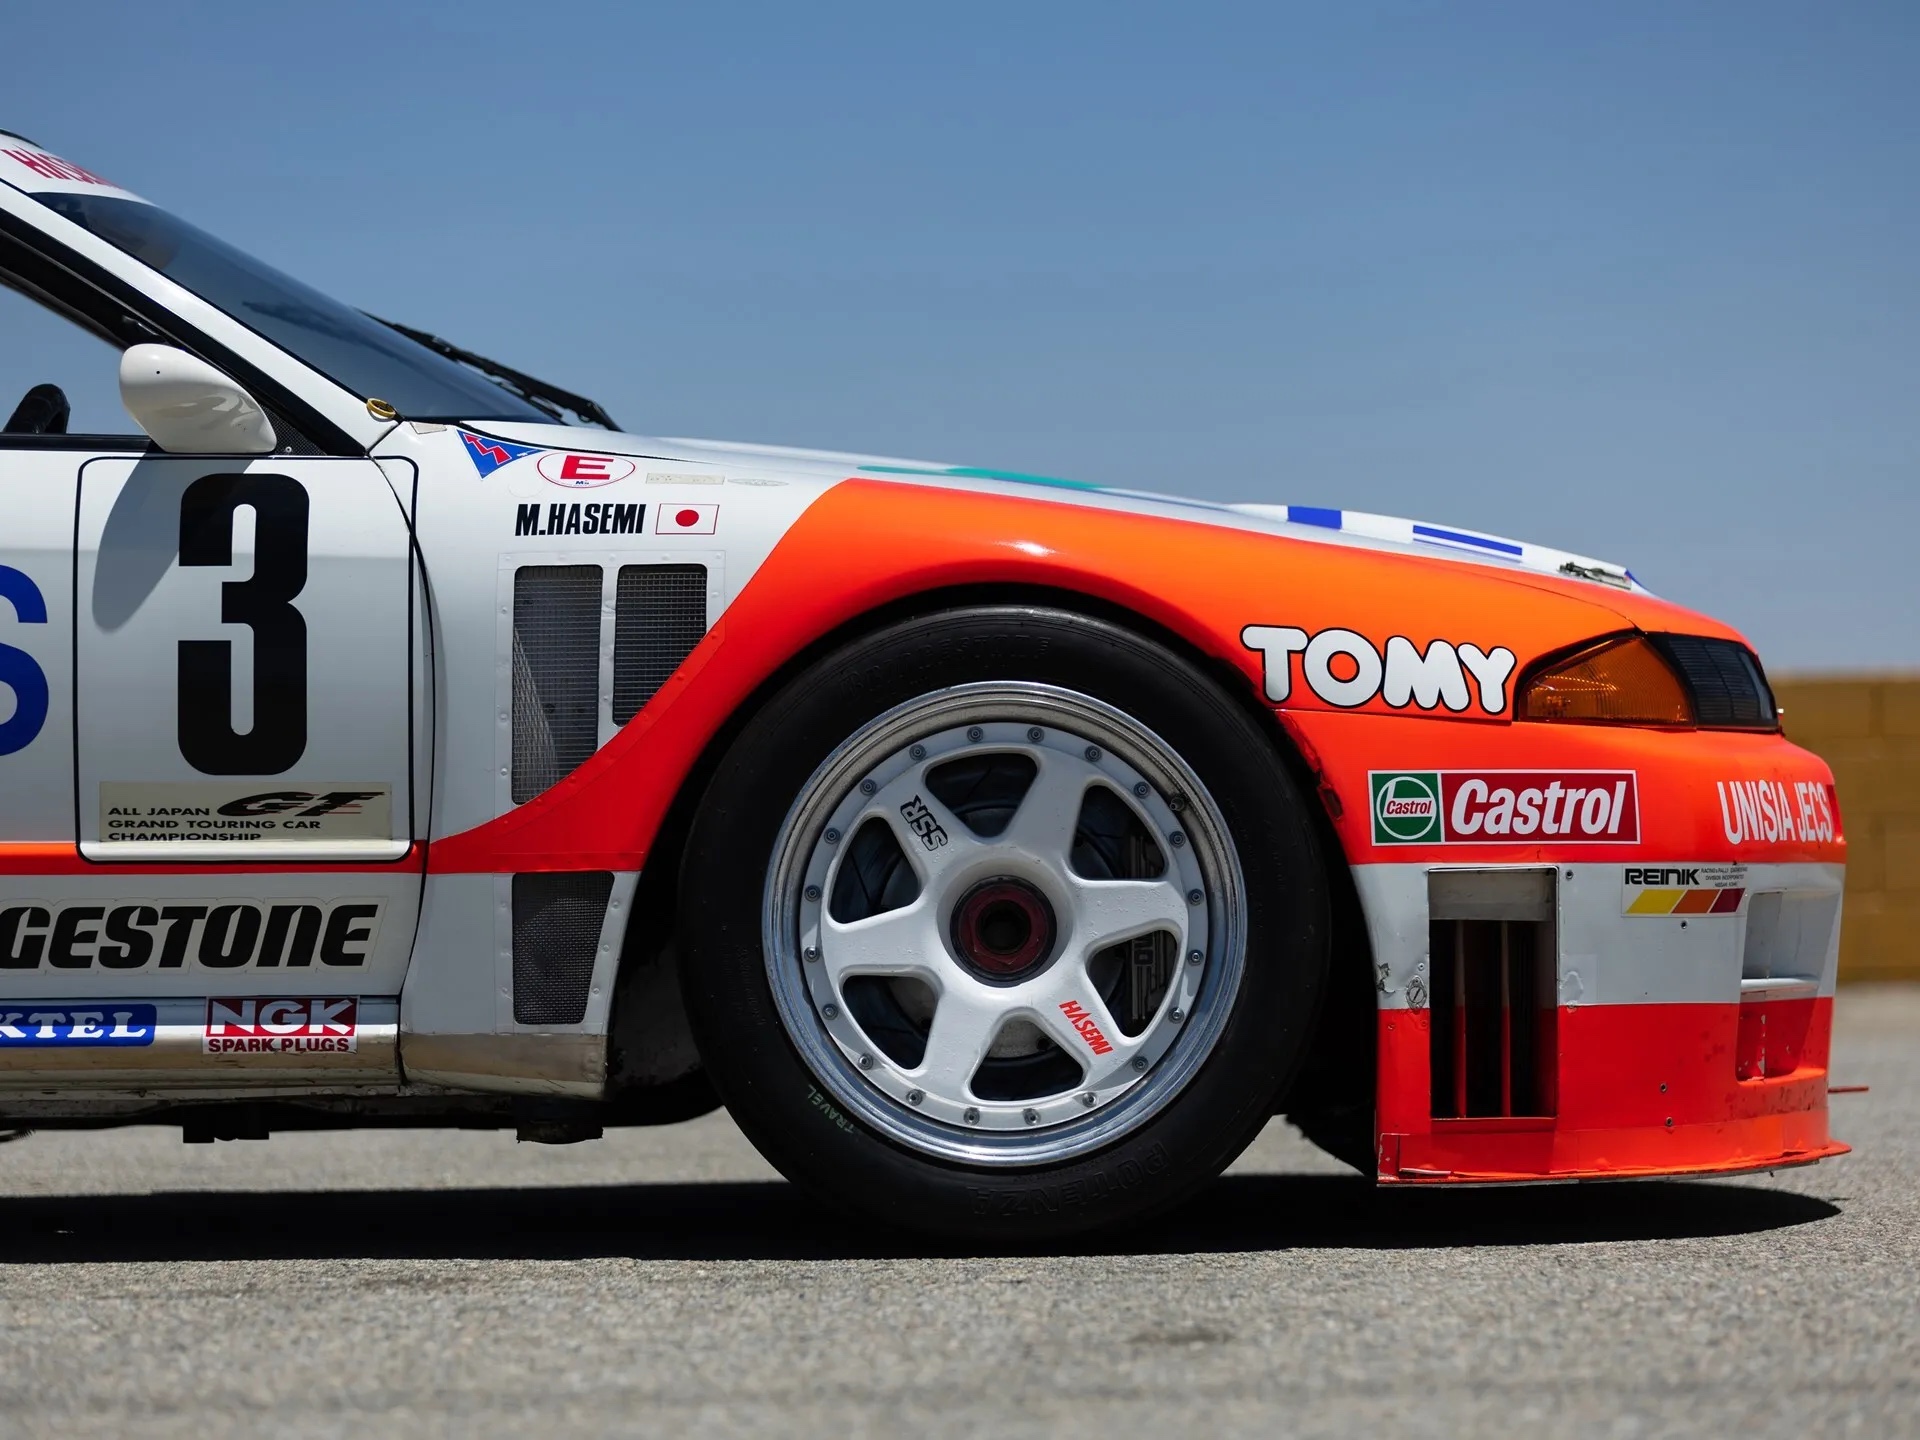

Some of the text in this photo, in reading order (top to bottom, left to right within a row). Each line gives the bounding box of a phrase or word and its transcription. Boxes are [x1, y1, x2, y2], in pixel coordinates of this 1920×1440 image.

[560, 455, 614, 480] E
[514, 503, 647, 536] M.HASEMI
[178, 473, 310, 775] 3
[1241, 624, 1518, 714] TOMY
[108, 807, 141, 816] ALL
[147, 807, 210, 816] JAPAN
[108, 820, 321, 829] GRAND TOURING CAR
[900, 794, 949, 852] SSR
[1385, 798, 1432, 816] Castrol
[1451, 778, 1627, 836] Castrol
[1716, 780, 1833, 845] UNISIA JECS
[108, 832, 261, 841] CHAMPIONSHIP
[1625, 868, 1700, 886] REINIK
[0, 904, 379, 969] GESTONE
[210, 1000, 354, 1035] NGK
[1059, 1000, 1114, 1055] HASEMI
[208, 1037, 349, 1052] SPARK PLUGS
[808, 1084, 855, 1134] TRAVEL
